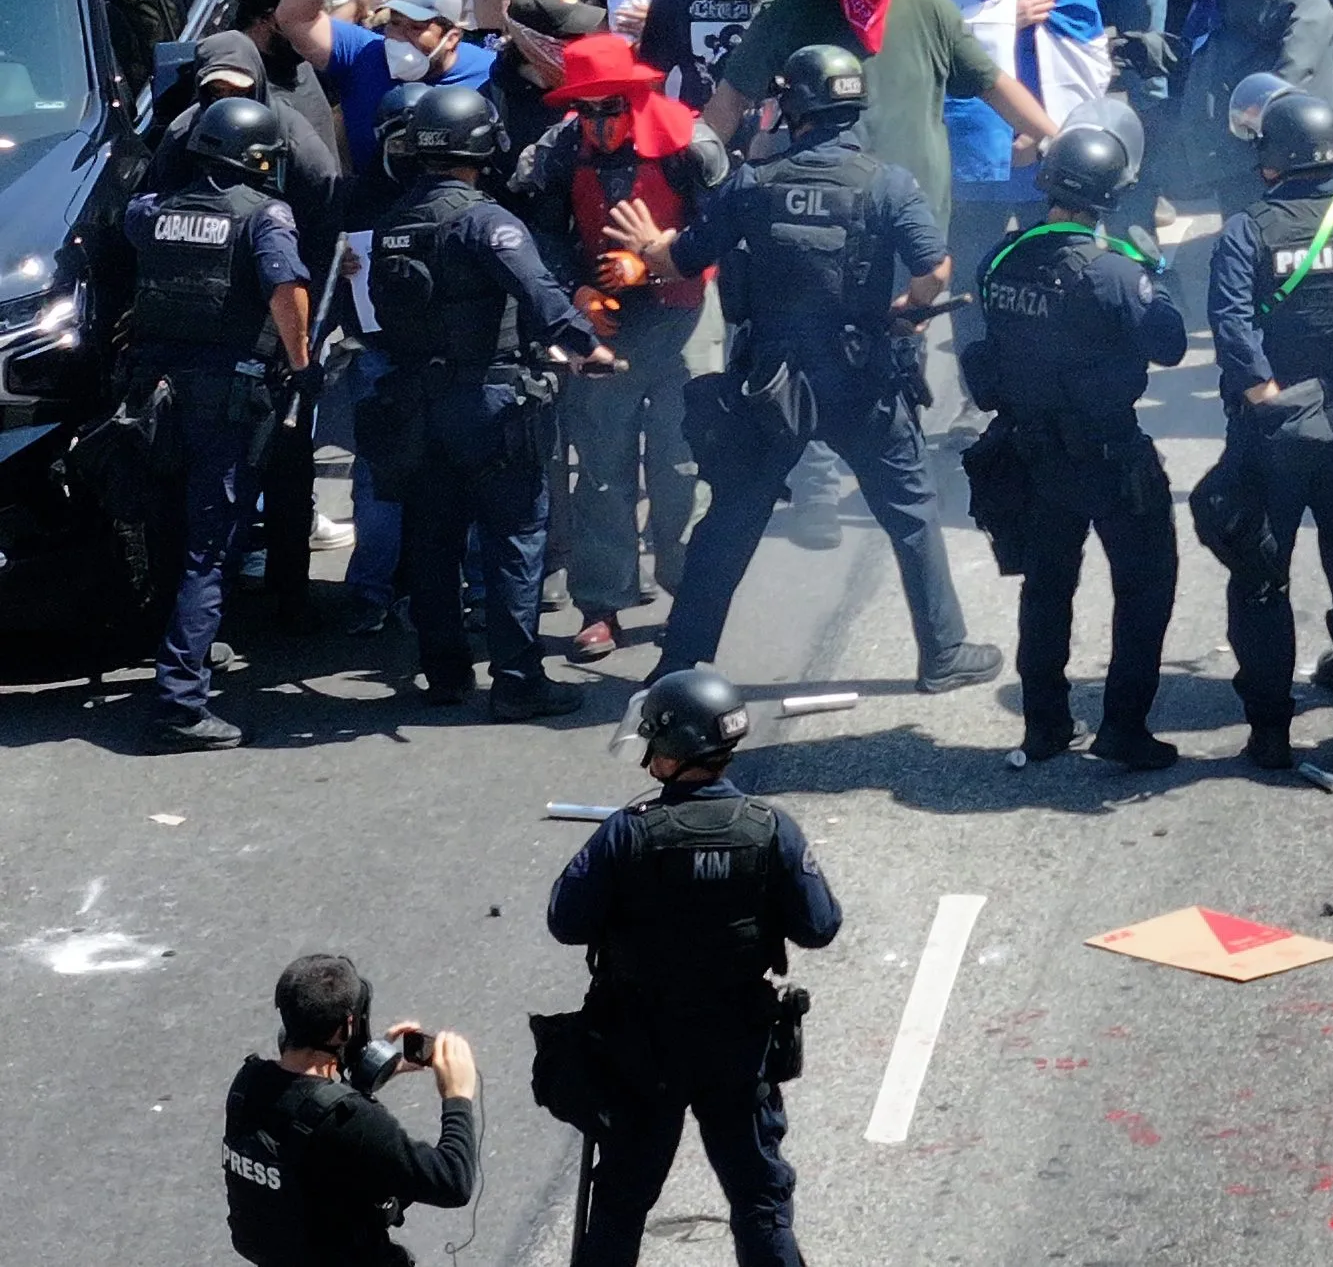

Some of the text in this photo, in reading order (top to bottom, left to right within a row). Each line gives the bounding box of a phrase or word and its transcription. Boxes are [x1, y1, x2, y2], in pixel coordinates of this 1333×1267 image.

[785, 188, 831, 216] GIL
[154, 214, 230, 244] CABALLERO
[382, 234, 411, 249] POLICE
[990, 282, 1049, 319] PERAZA
[694, 851, 731, 880] KIM
[222, 1142, 281, 1190] PRESS
